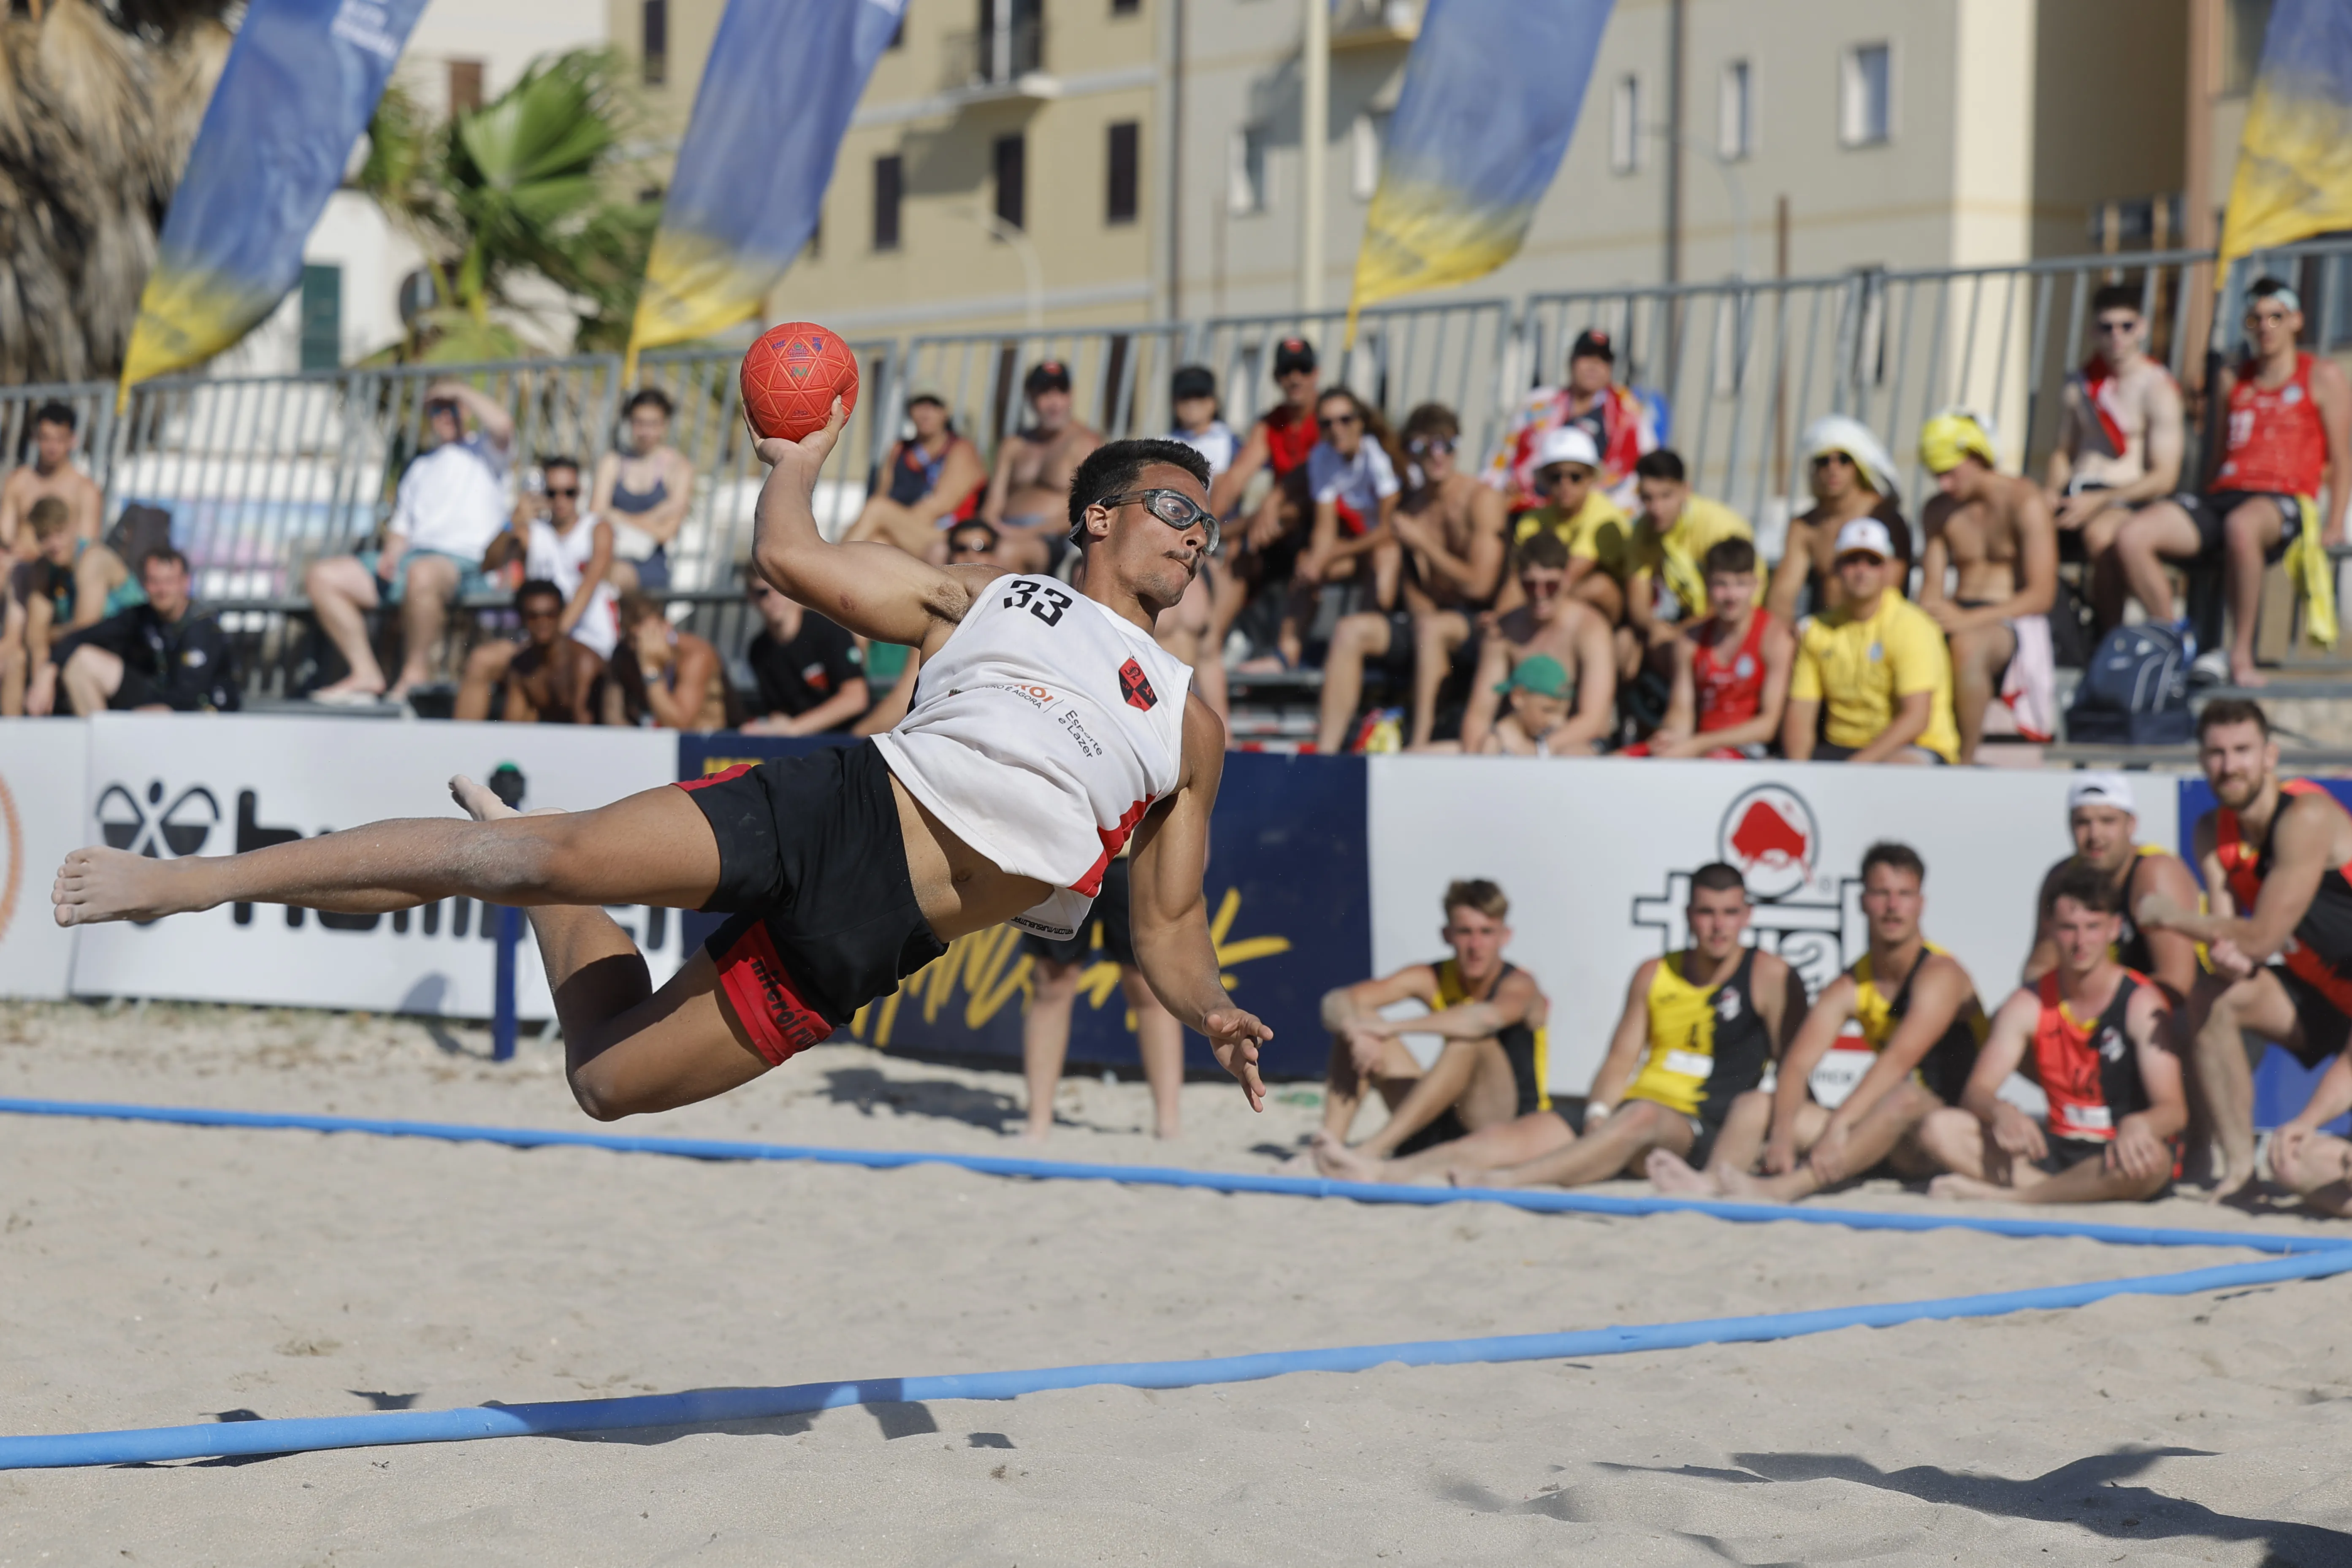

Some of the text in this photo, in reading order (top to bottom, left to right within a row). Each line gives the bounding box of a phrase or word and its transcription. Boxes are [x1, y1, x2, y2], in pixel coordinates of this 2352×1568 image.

[1003, 580, 1073, 627] 33
[1012, 689, 1042, 709] AGORA
[1065, 710, 1102, 756] Esporte
[1067, 725, 1093, 757] Lazer
